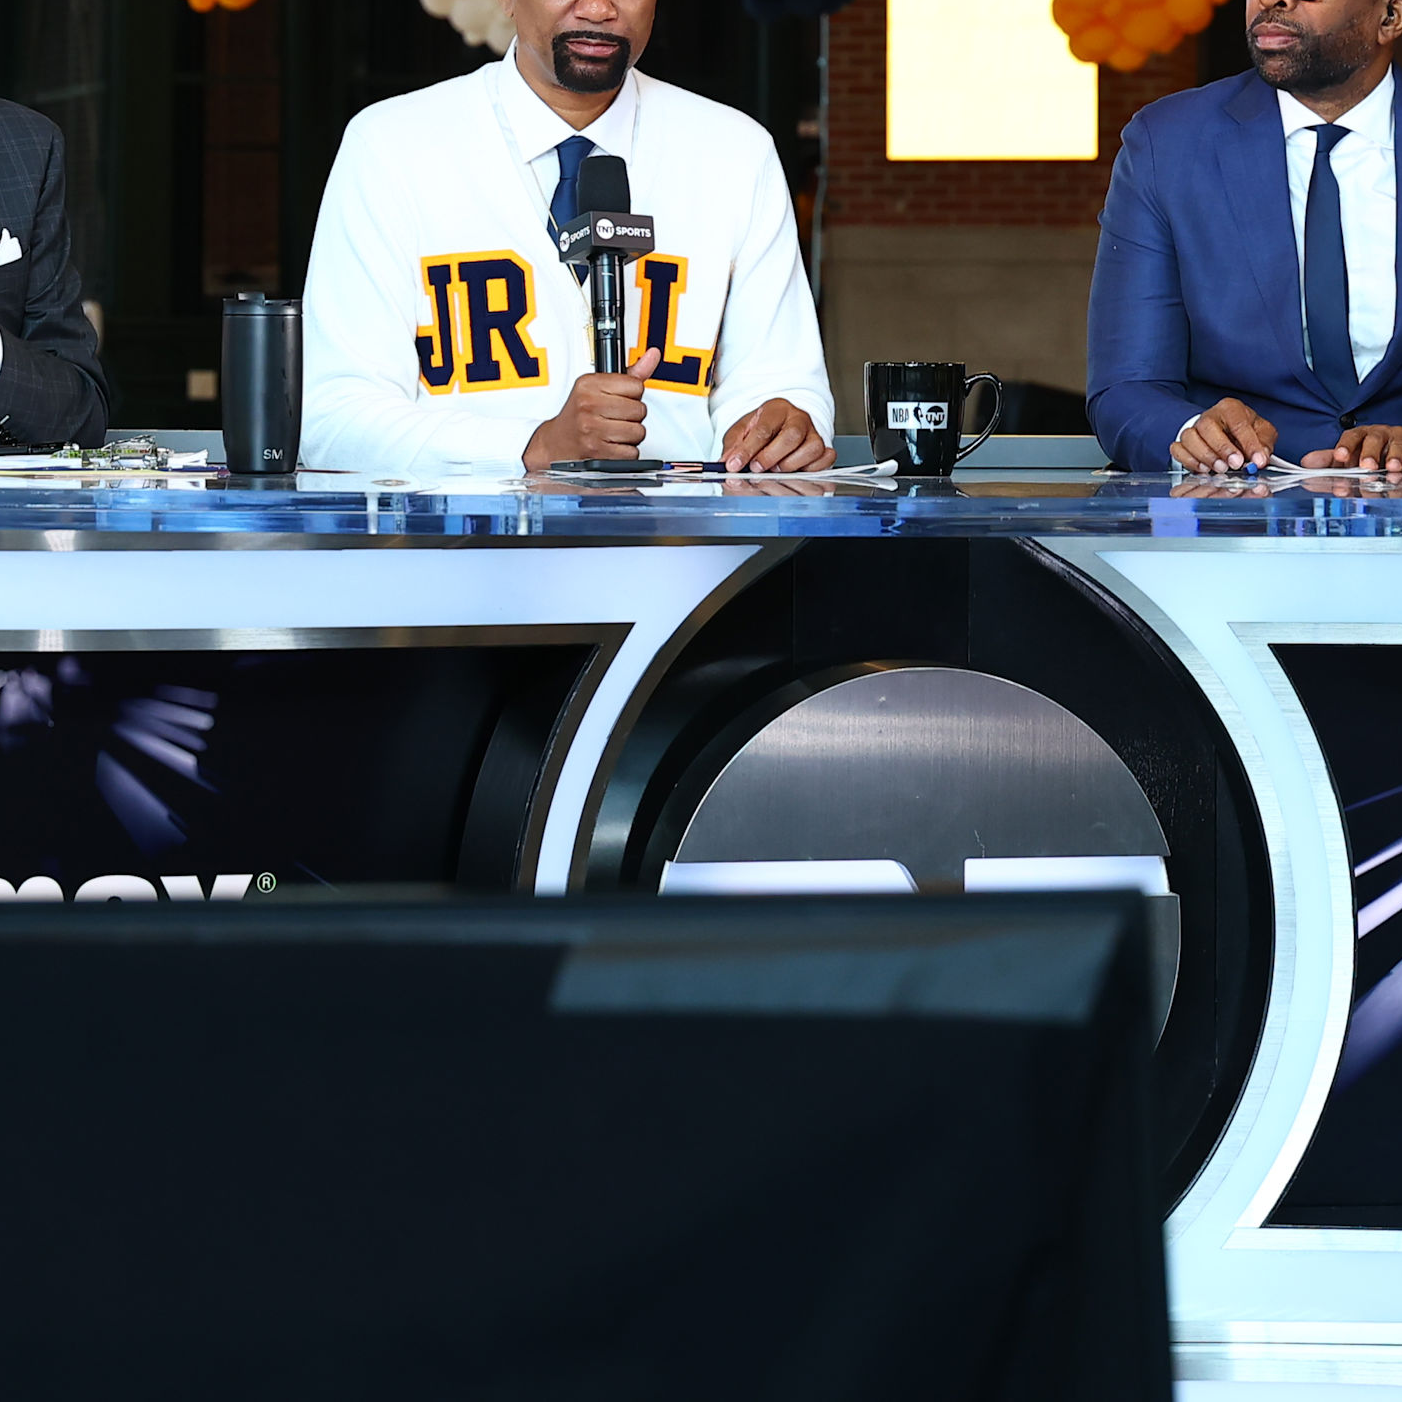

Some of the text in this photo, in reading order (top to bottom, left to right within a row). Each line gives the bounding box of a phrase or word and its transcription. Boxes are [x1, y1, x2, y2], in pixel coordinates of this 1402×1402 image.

[570, 225, 591, 244] SPORTS
[615, 225, 652, 238] SPORTS
[415, 250, 717, 397] JR L
[892, 407, 910, 423] NBA
[262, 448, 284, 460] SM
